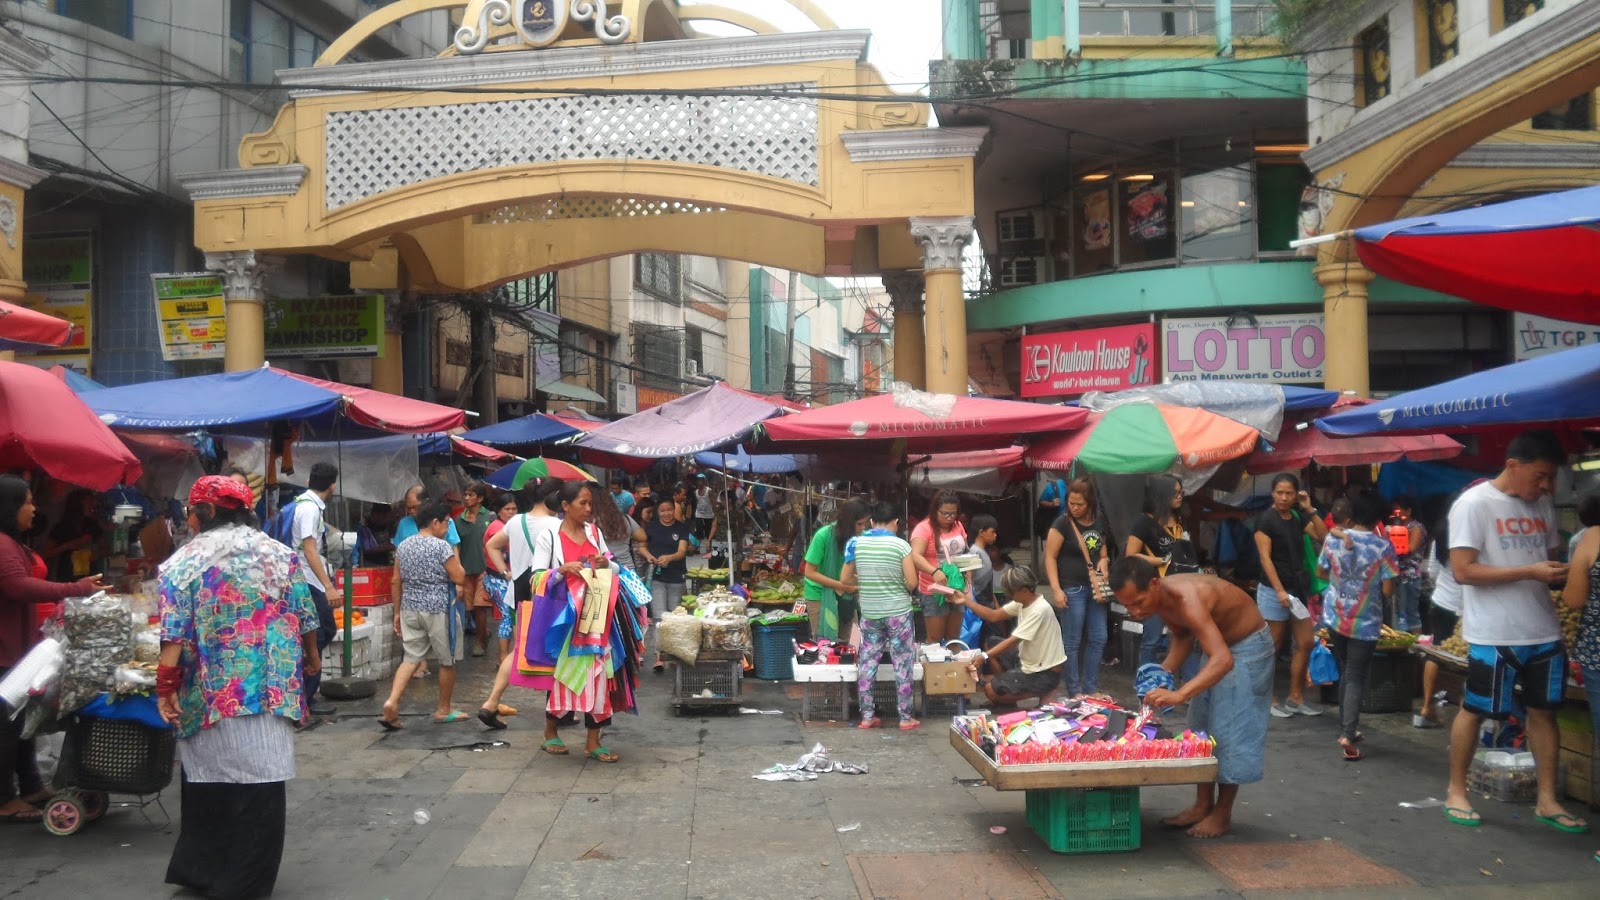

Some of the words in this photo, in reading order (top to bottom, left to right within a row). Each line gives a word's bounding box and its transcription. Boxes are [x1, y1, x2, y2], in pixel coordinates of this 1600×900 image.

[1550, 330, 1586, 346] TGP
[1052, 342, 1094, 374] Kowloon
[1095, 339, 1131, 371] House
[1167, 324, 1326, 373] LOTTO
[1272, 370, 1311, 379] Outlet
[1315, 370, 1323, 378] 2
[1403, 392, 1512, 418] MICROMATIC
[123, 416, 235, 428] MICROMATIC
[879, 418, 989, 433] MICROMATIC
[1496, 516, 1548, 536] ICON
